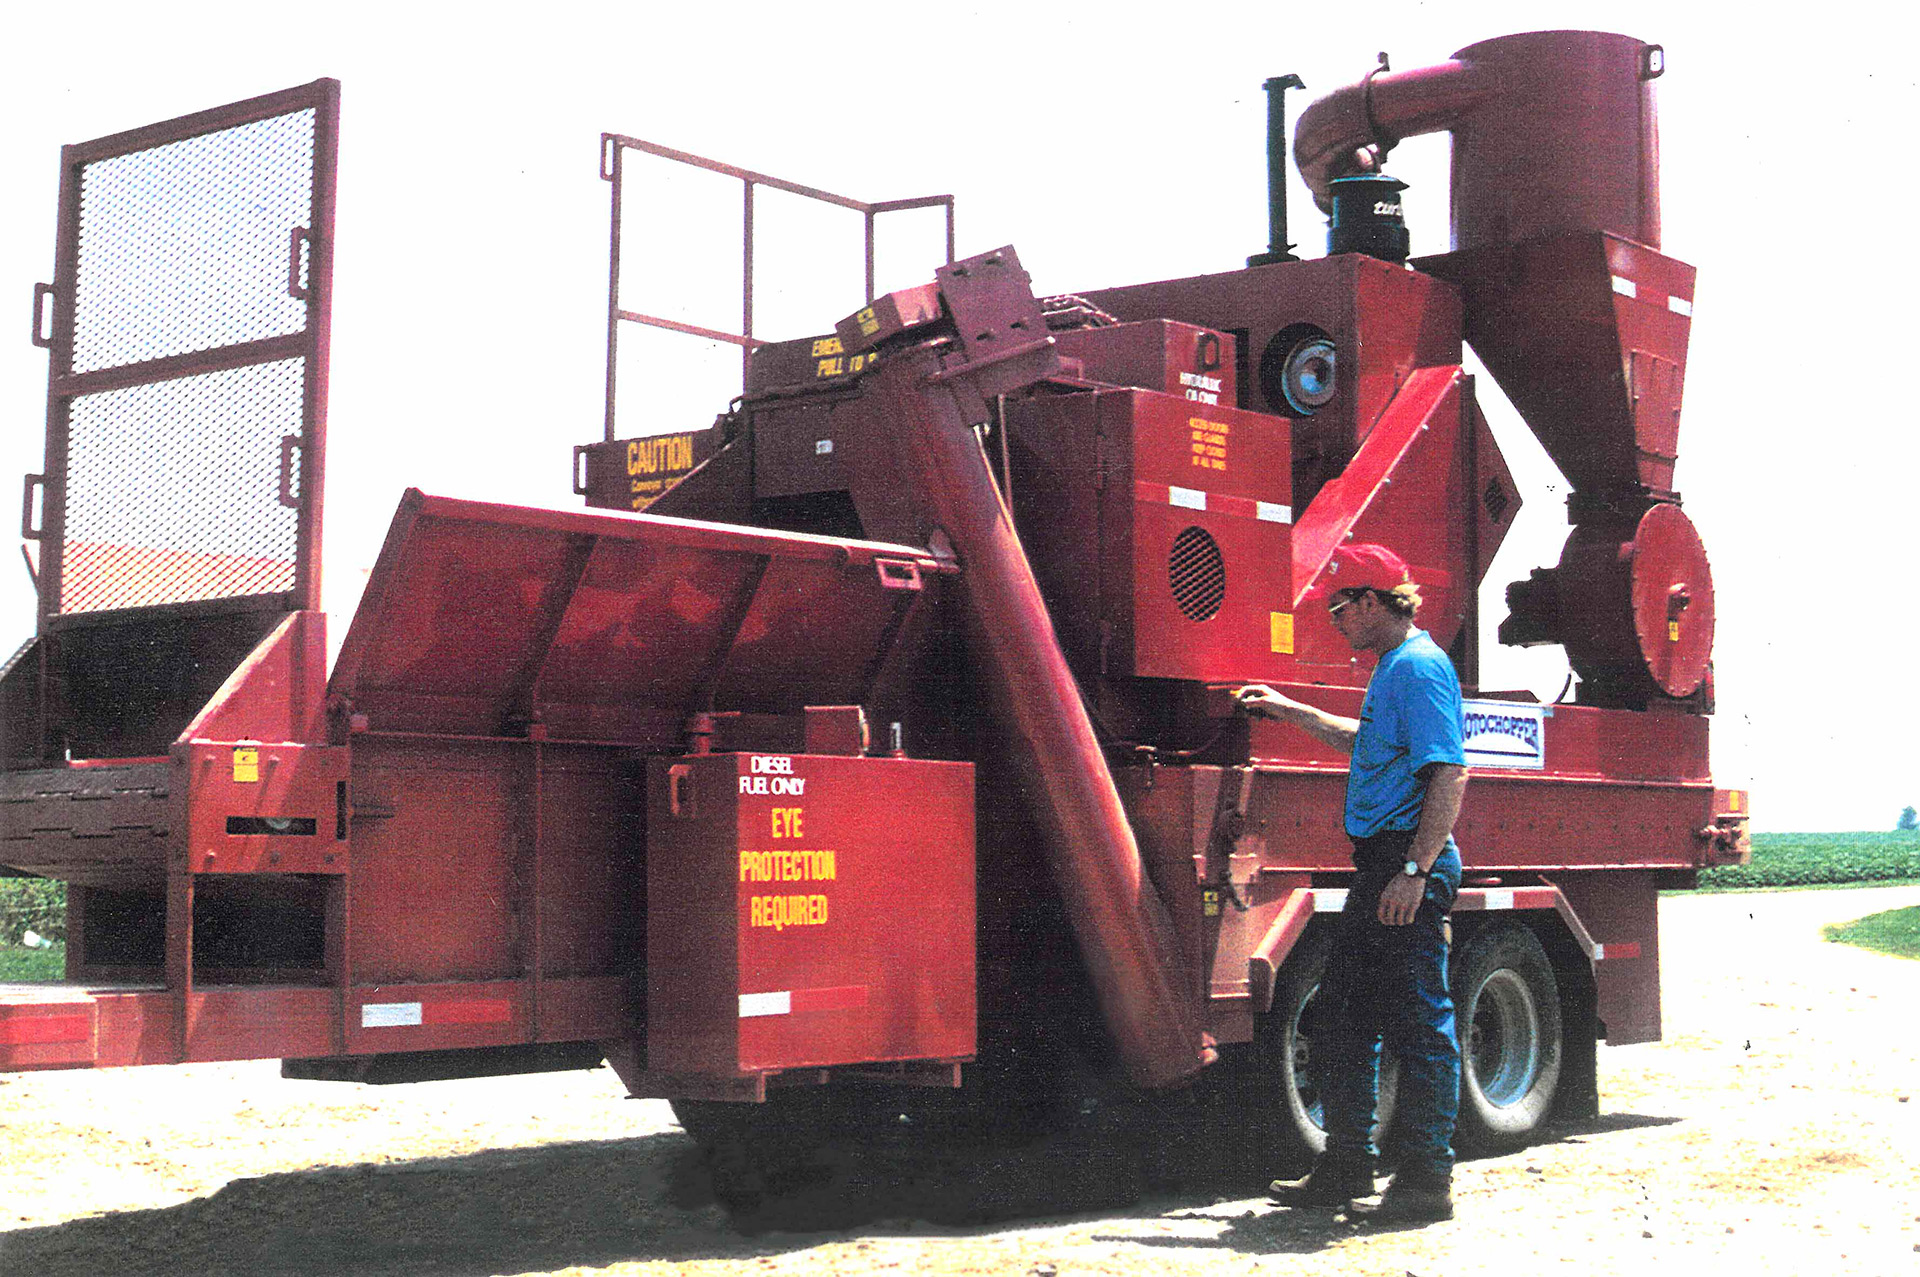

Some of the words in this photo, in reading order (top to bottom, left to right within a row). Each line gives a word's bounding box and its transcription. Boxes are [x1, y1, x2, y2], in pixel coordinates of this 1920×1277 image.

[817, 357, 843, 377] PULL
[849, 355, 864, 372] TO
[627, 435, 693, 476] CAUTION
[750, 756, 794, 774] DIESEL
[739, 776, 770, 794] FUEL
[771, 777, 806, 795] ONLY
[771, 808, 803, 838] EYE
[739, 850, 836, 882] PROTECTION
[751, 894, 829, 931] REQUIRED
